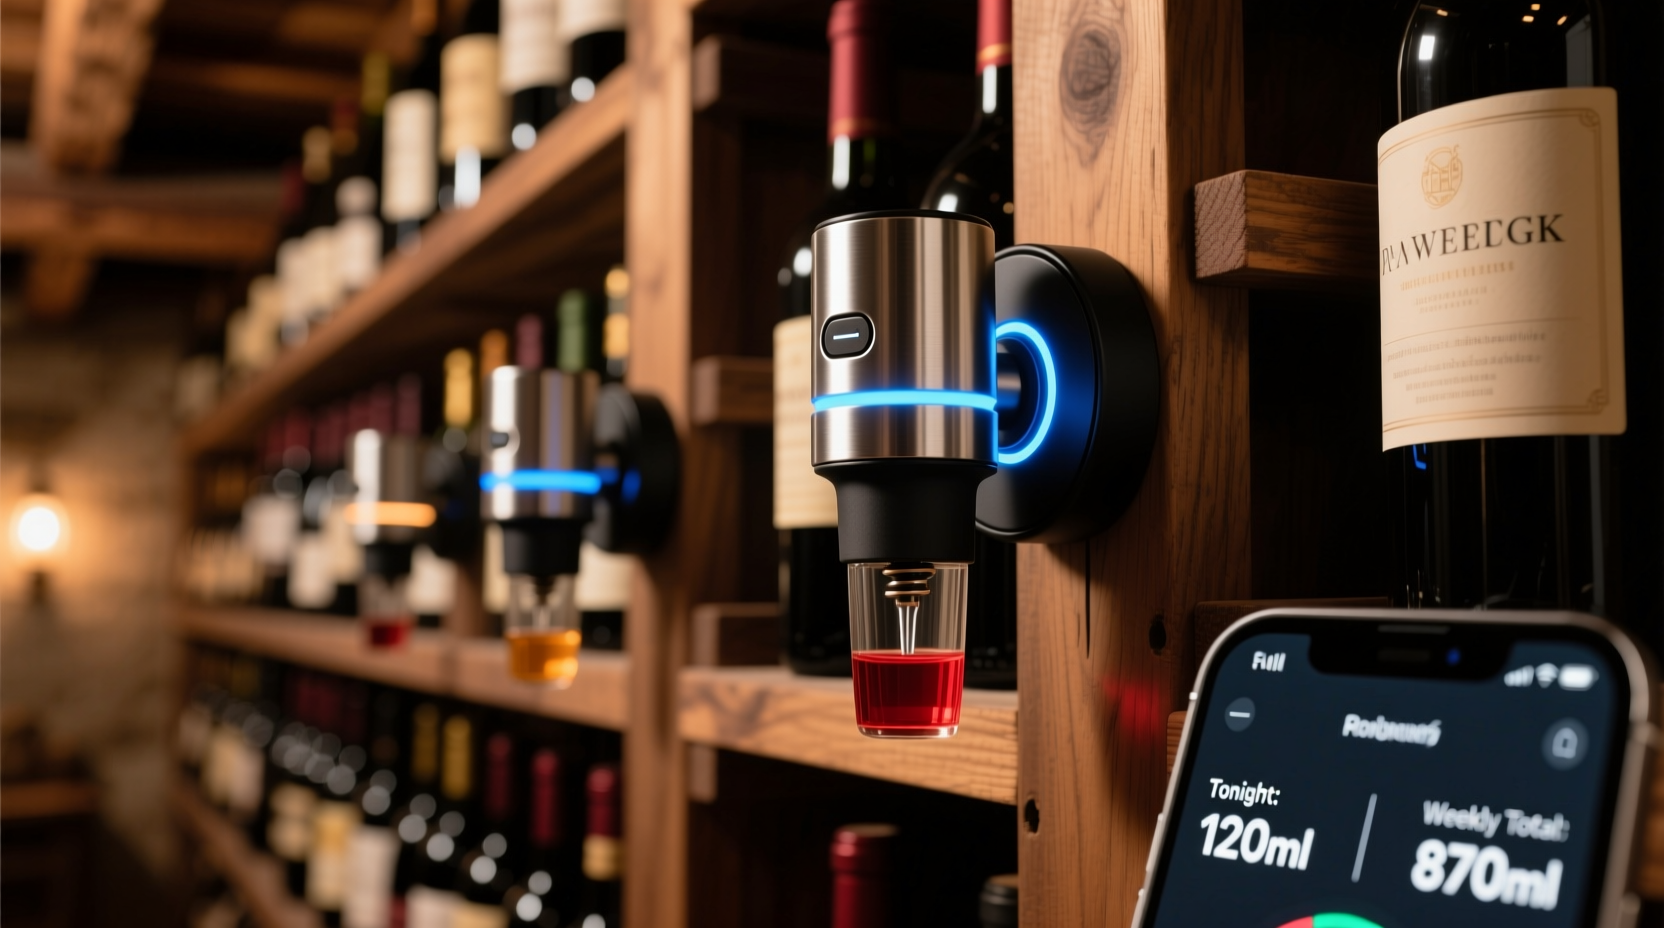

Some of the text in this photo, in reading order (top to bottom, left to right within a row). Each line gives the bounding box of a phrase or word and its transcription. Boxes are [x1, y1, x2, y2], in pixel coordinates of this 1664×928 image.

[1209, 777, 1281, 807] Tonight:
[1200, 812, 1315, 871] 120ml
[1422, 799, 1502, 839] Weekly
[1410, 838, 1564, 912] 870ml
